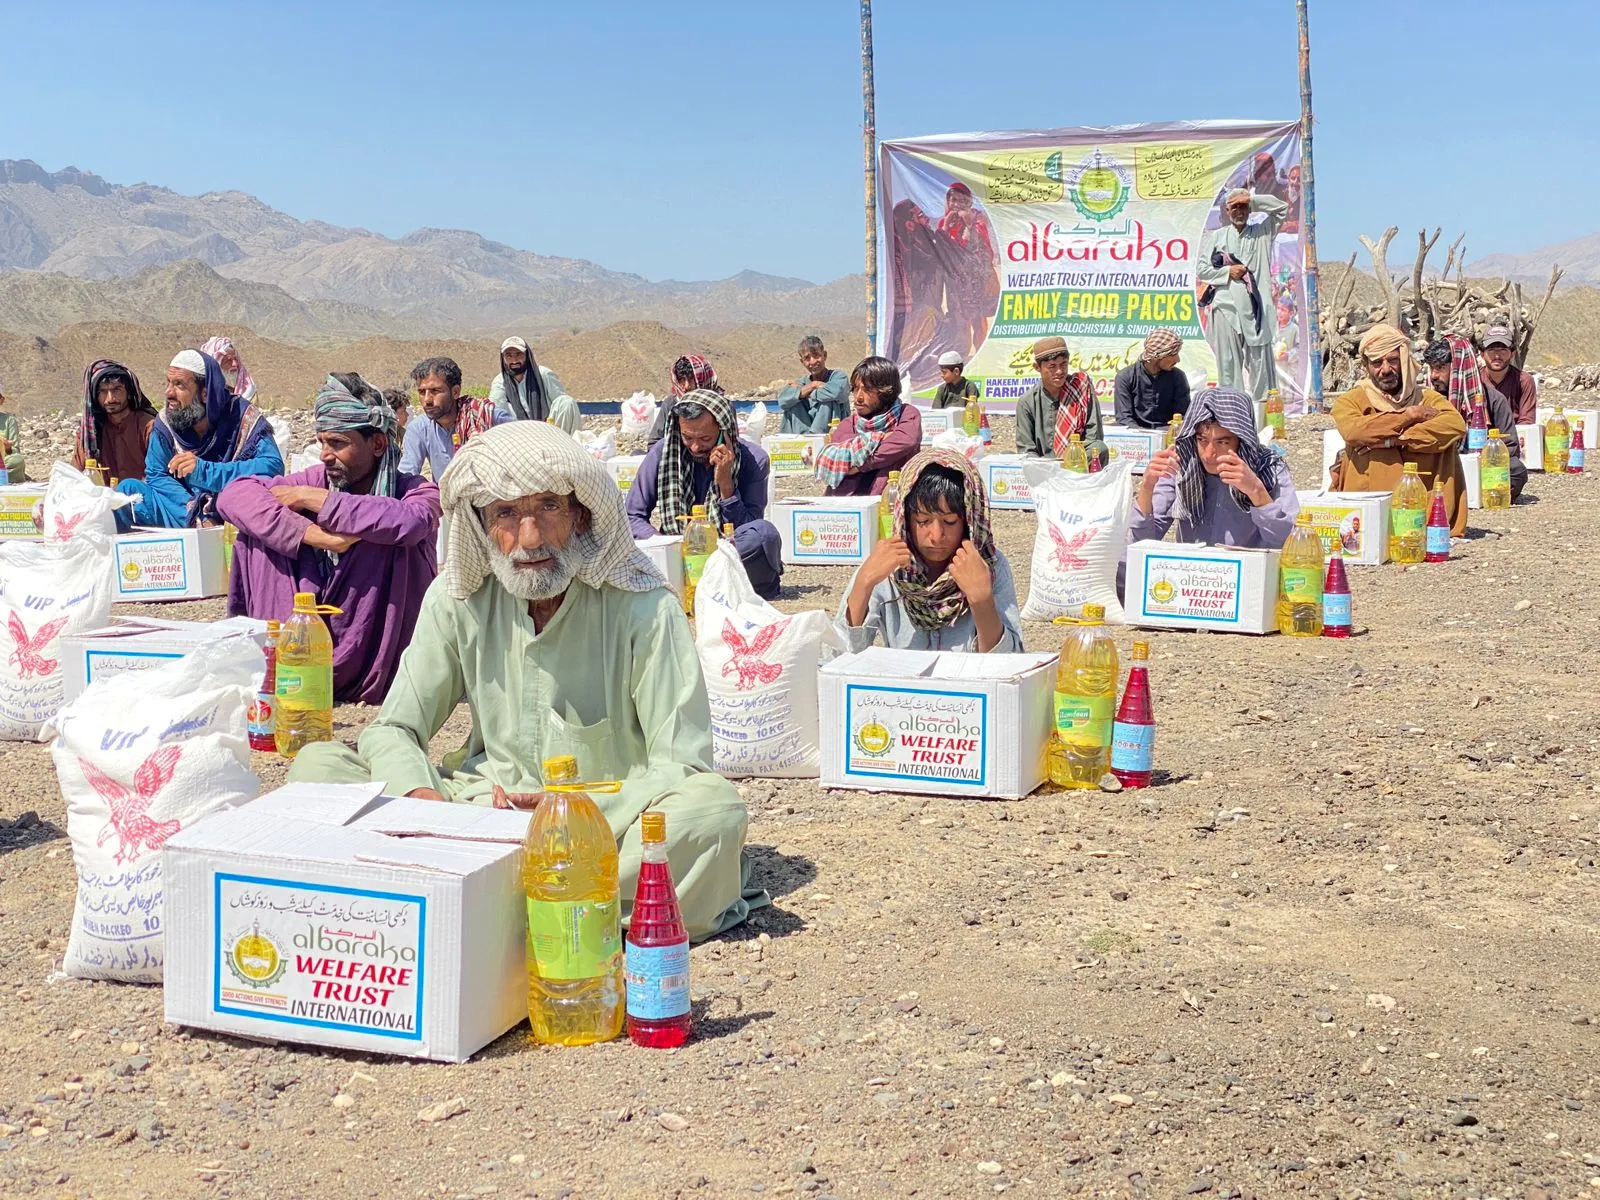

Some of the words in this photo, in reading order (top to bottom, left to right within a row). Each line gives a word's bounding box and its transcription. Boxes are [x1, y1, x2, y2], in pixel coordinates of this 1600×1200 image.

[1007, 220, 1189, 269] albaraka
[1008, 272, 1056, 288] WELFARE
[1056, 272, 1094, 287] TRUST
[1094, 272, 1189, 288] INTERNATIONAL
[1003, 291, 1061, 321] FAMILY
[1066, 292, 1120, 319] FOOD
[1126, 292, 1192, 321] PACKS
[993, 322, 1047, 336] DISTRIBUTION
[1048, 322, 1056, 333] IN
[1057, 322, 1117, 335] BALOCHISTAN
[1118, 323, 1124, 335] &
[1126, 324, 1156, 336] SINDH
[986, 378, 1018, 387] HAKEEM
[1060, 509, 1083, 525] VIP
[820, 533, 858, 541] WELFARE
[144, 564, 182, 573] WELFARE
[150, 573, 177, 581] TRUST
[1180, 574, 1236, 590] albaraka
[1181, 588, 1235, 600] WELFARE
[24, 595, 55, 611] VIP
[1188, 598, 1227, 609] TRUST
[1178, 607, 1235, 619] INTERNATIONAL
[899, 713, 980, 738] albaraka
[900, 734, 979, 752] WELFARE
[912, 750, 967, 765] TRUST
[898, 763, 980, 780] INTERNATIONAL
[101, 923, 132, 936] PACKED
[143, 915, 160, 931] 10
[293, 923, 416, 965] albaraka
[296, 954, 413, 986] WELFARE
[222, 991, 234, 999] GOOD
[312, 980, 395, 1007] TRUST
[291, 1000, 415, 1031] INTERNATIONAL
